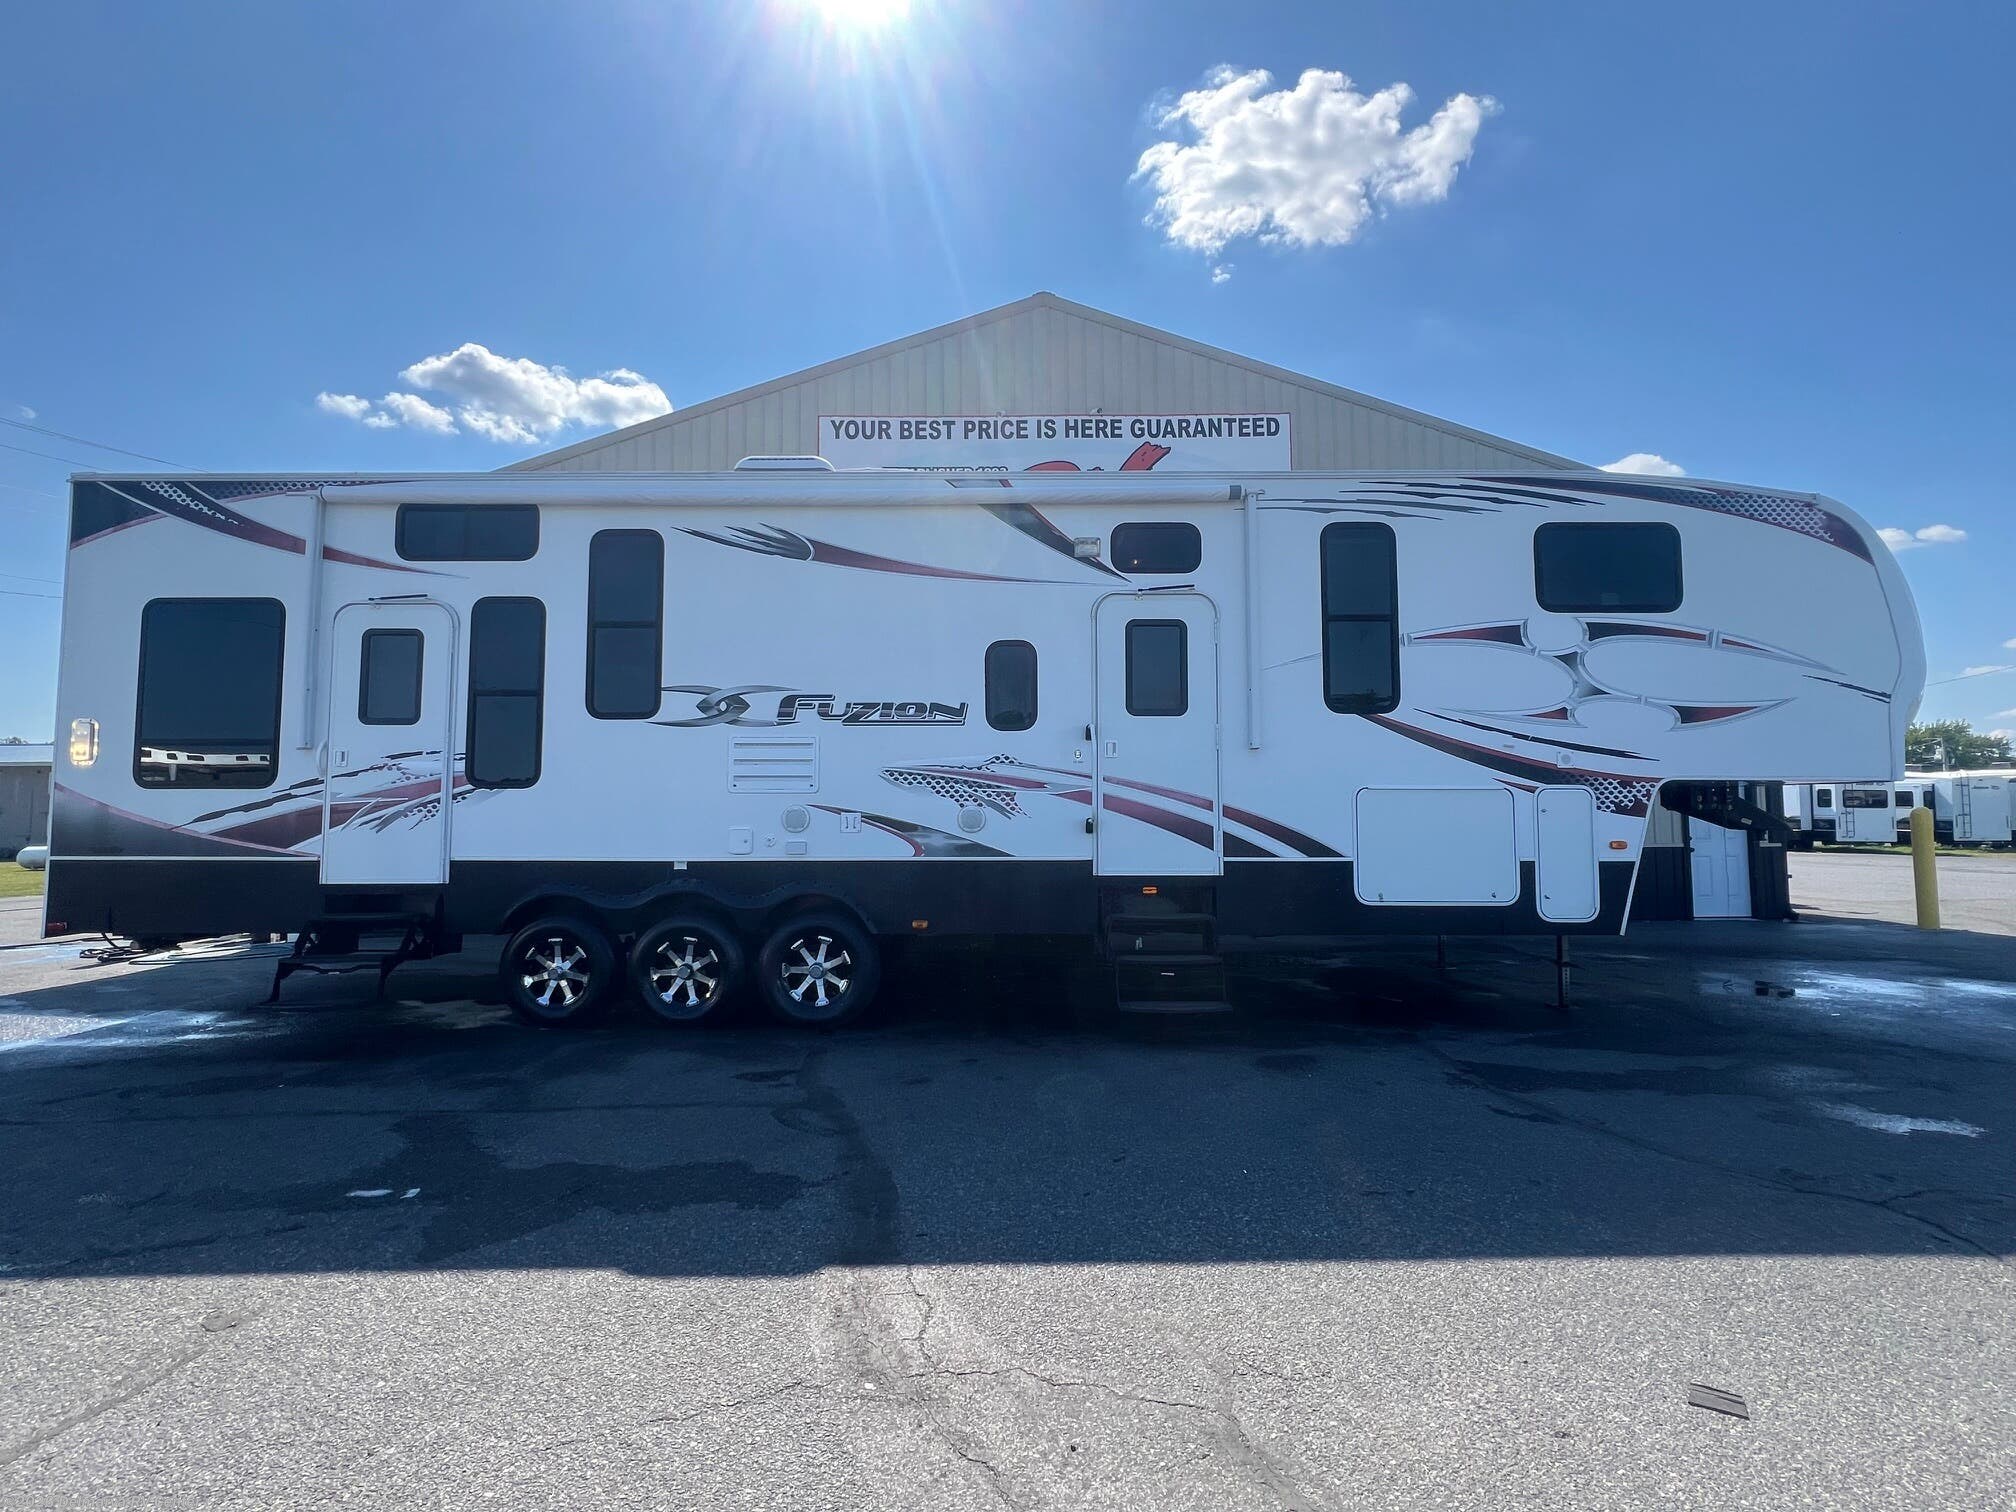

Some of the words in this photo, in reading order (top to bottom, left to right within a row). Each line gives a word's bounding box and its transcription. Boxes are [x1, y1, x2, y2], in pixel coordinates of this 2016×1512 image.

[830, 420, 892, 440] YOUR
[900, 420, 956, 440] BEST
[963, 420, 1029, 440] PRICE
[1036, 418, 1057, 439] IS
[1064, 418, 1123, 439] HERE
[1130, 417, 1280, 438] GUARANTEED
[778, 693, 967, 727] FUZION
